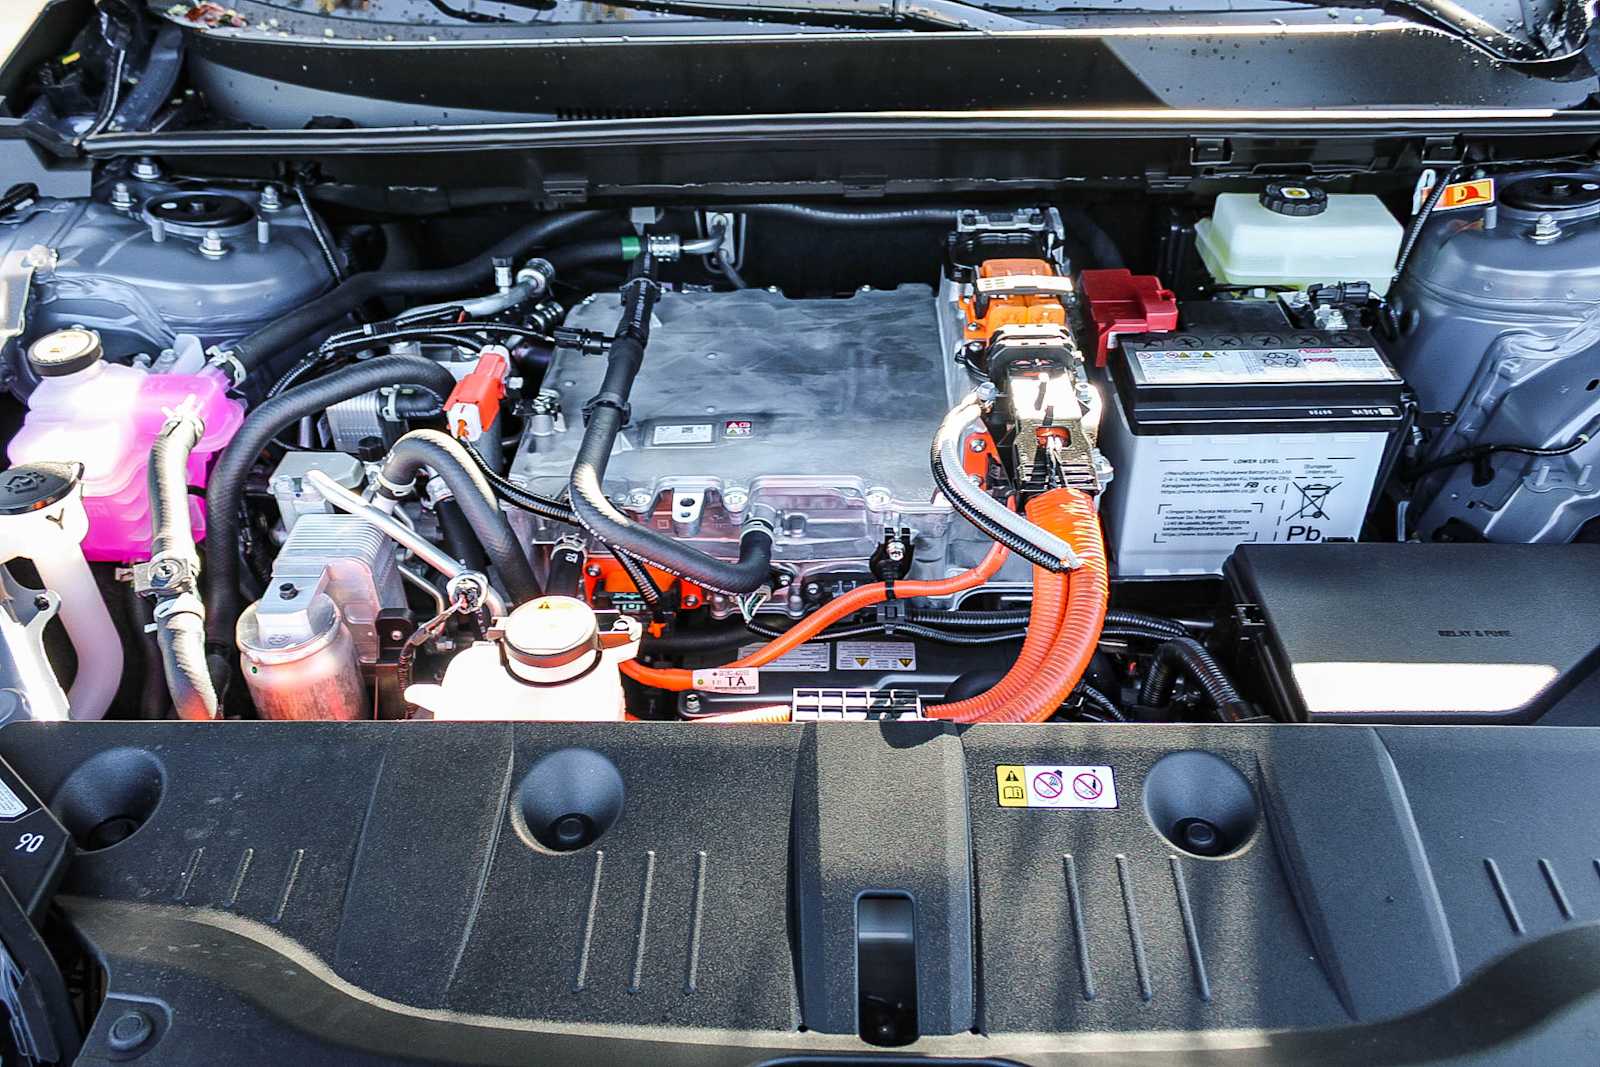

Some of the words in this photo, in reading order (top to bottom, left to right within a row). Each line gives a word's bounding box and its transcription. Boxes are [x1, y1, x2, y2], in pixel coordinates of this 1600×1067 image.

[1286, 525, 1321, 542] Pb
[724, 676, 746, 687] TA
[14, 833, 45, 853] 90
